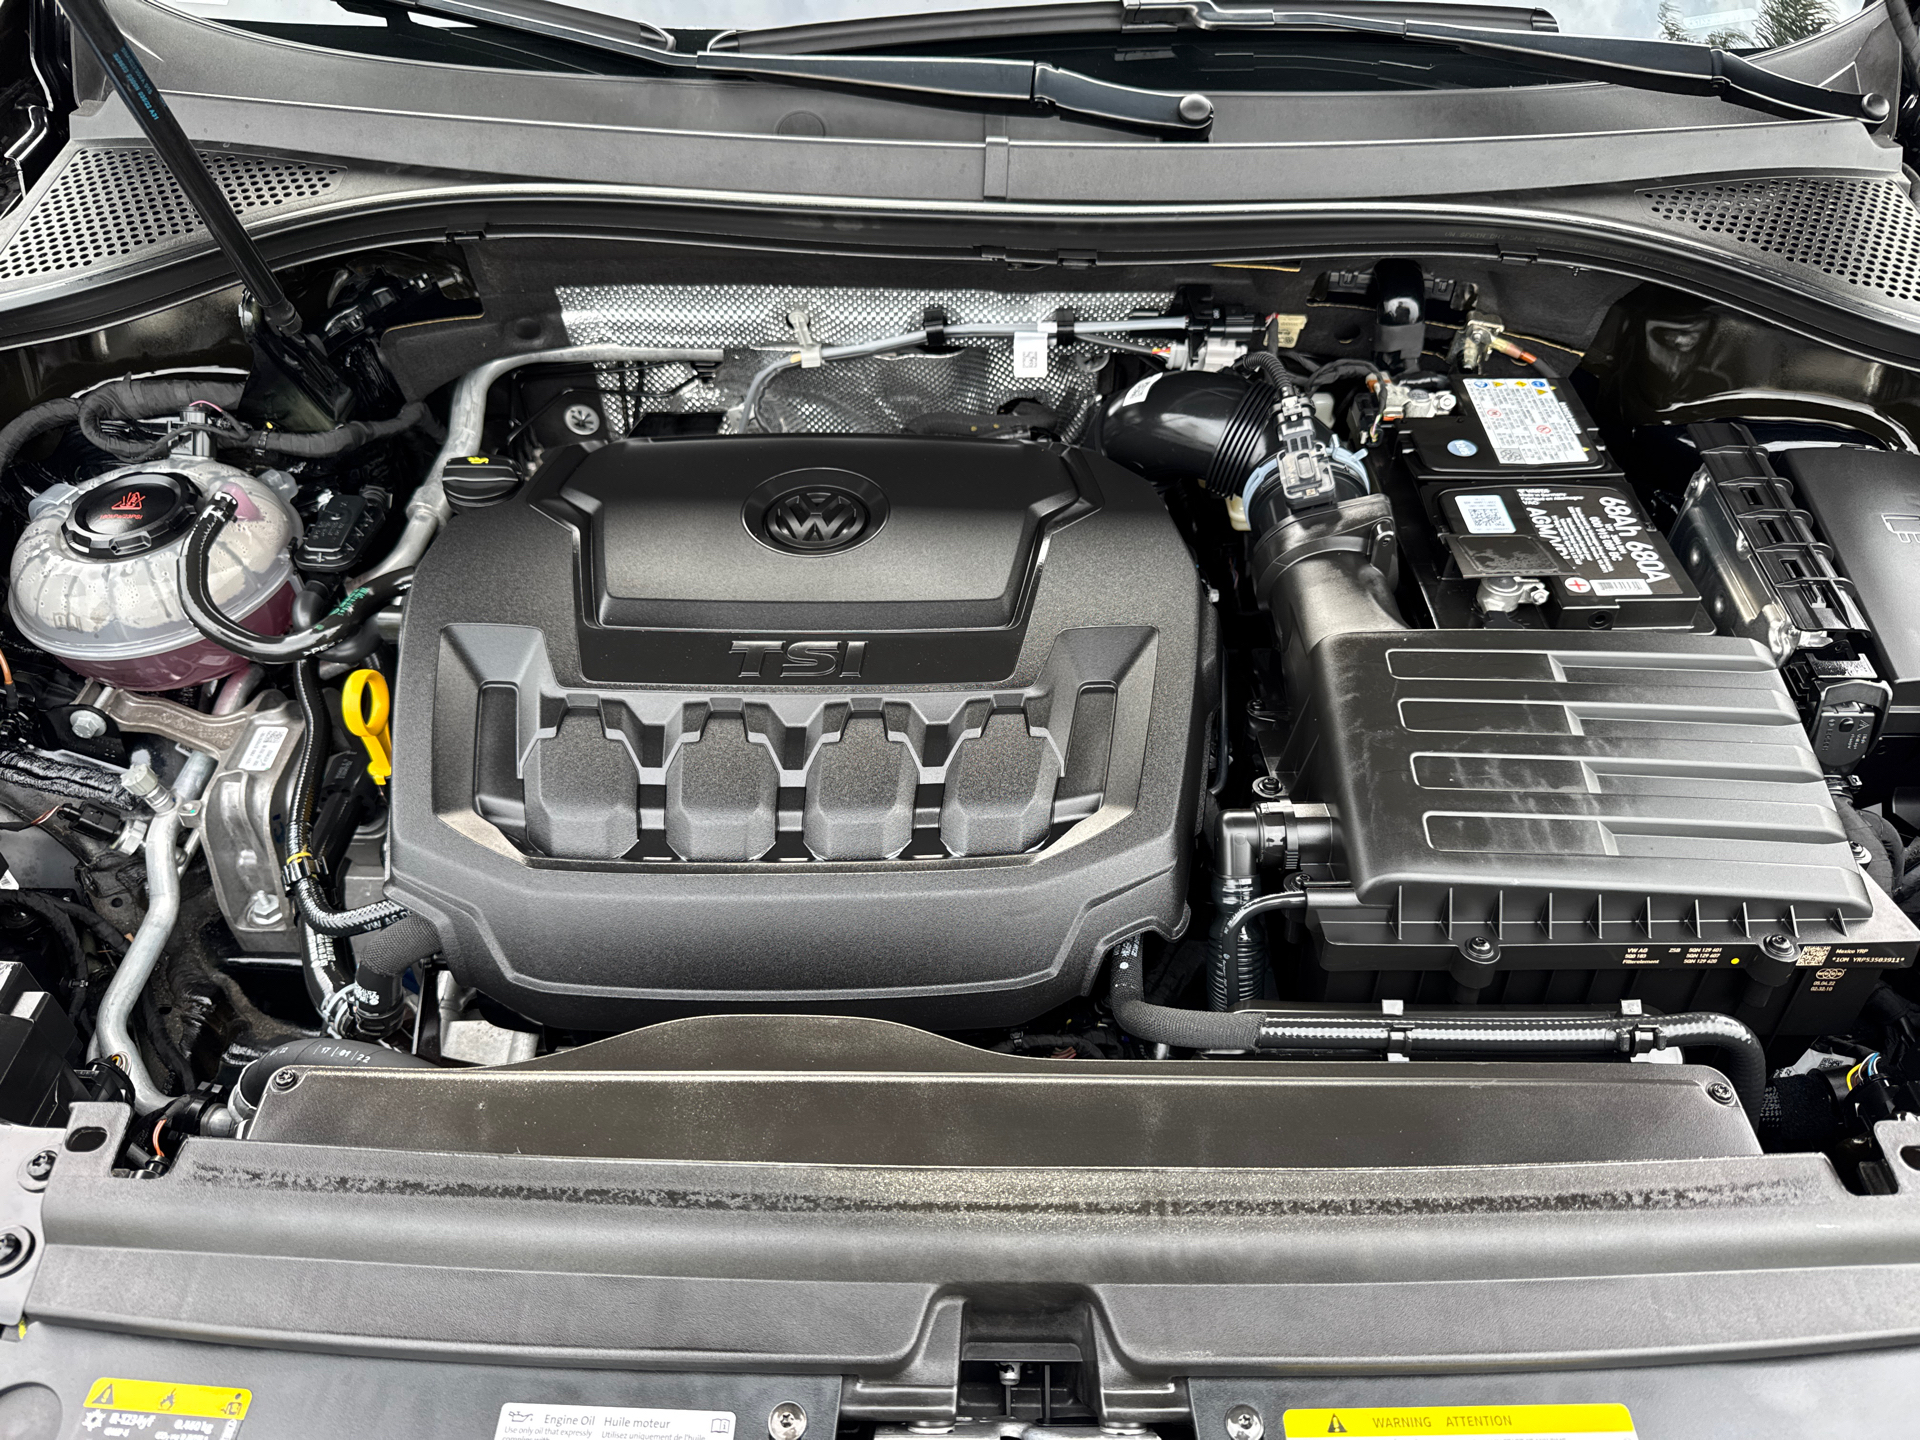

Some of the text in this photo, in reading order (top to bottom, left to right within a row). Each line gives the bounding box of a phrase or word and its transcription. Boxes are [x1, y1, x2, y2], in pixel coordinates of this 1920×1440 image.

[1599, 496, 1671, 583] 68Ah 680A
[729, 640, 869, 678] TSI
[364, 920, 382, 930] VW
[385, 914, 400, 925] AG
[544, 1414, 595, 1427] Engine Oil
[604, 1417, 670, 1429] Huile moteur
[1372, 1415, 1513, 1428] WARNING ATTENTION
[519, 1427, 534, 1435] only
[535, 1427, 543, 1435] oil
[545, 1428, 558, 1436] that
[560, 1429, 592, 1438] expressly
[602, 1431, 628, 1439] Utilisez
[629, 1432, 671, 1440] uniquement
